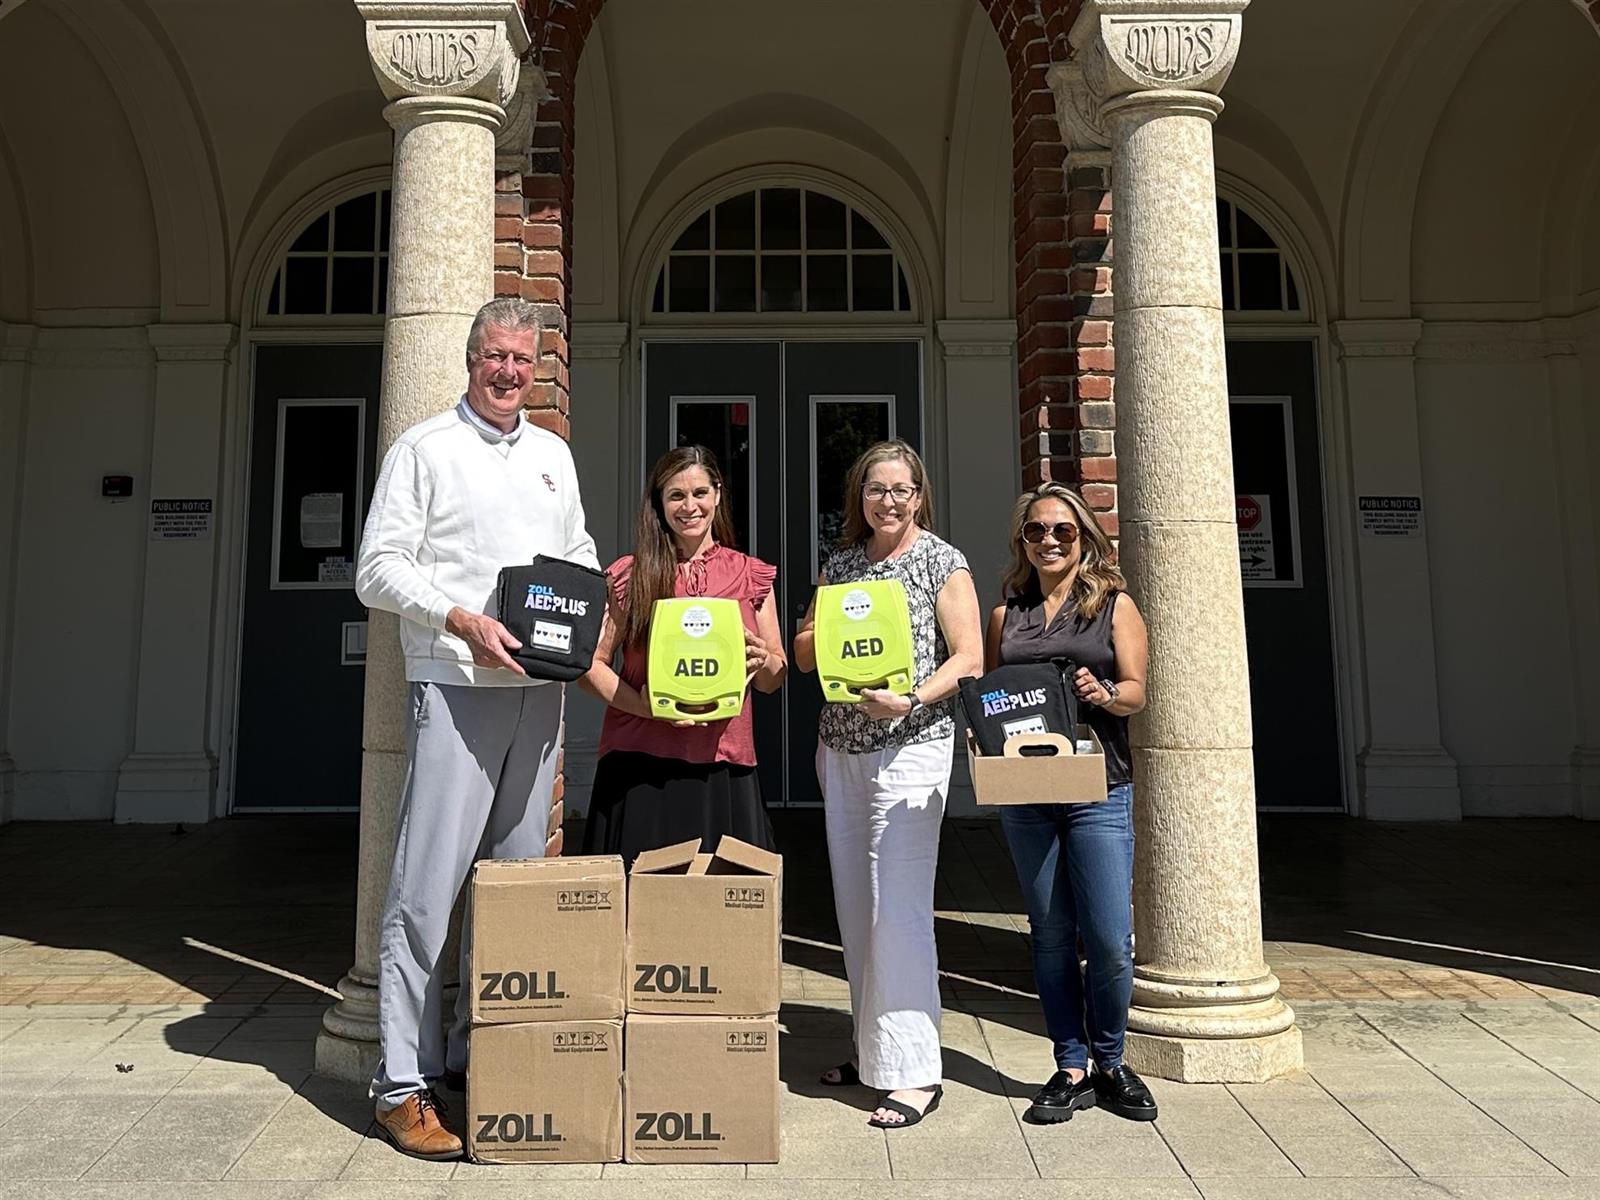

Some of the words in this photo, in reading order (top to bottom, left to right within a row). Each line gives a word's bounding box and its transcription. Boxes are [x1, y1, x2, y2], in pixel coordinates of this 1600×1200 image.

[153, 502, 181, 511] PUBLIC
[182, 502, 210, 511] NOTICE
[1361, 499, 1389, 509] PUBLIC
[1390, 499, 1418, 509] NOTICE
[1237, 508, 1257, 519] TOP
[527, 584, 556, 596] ZOLL
[841, 637, 885, 660] AED
[674, 658, 719, 677] AED
[980, 688, 1009, 704] ZOLL
